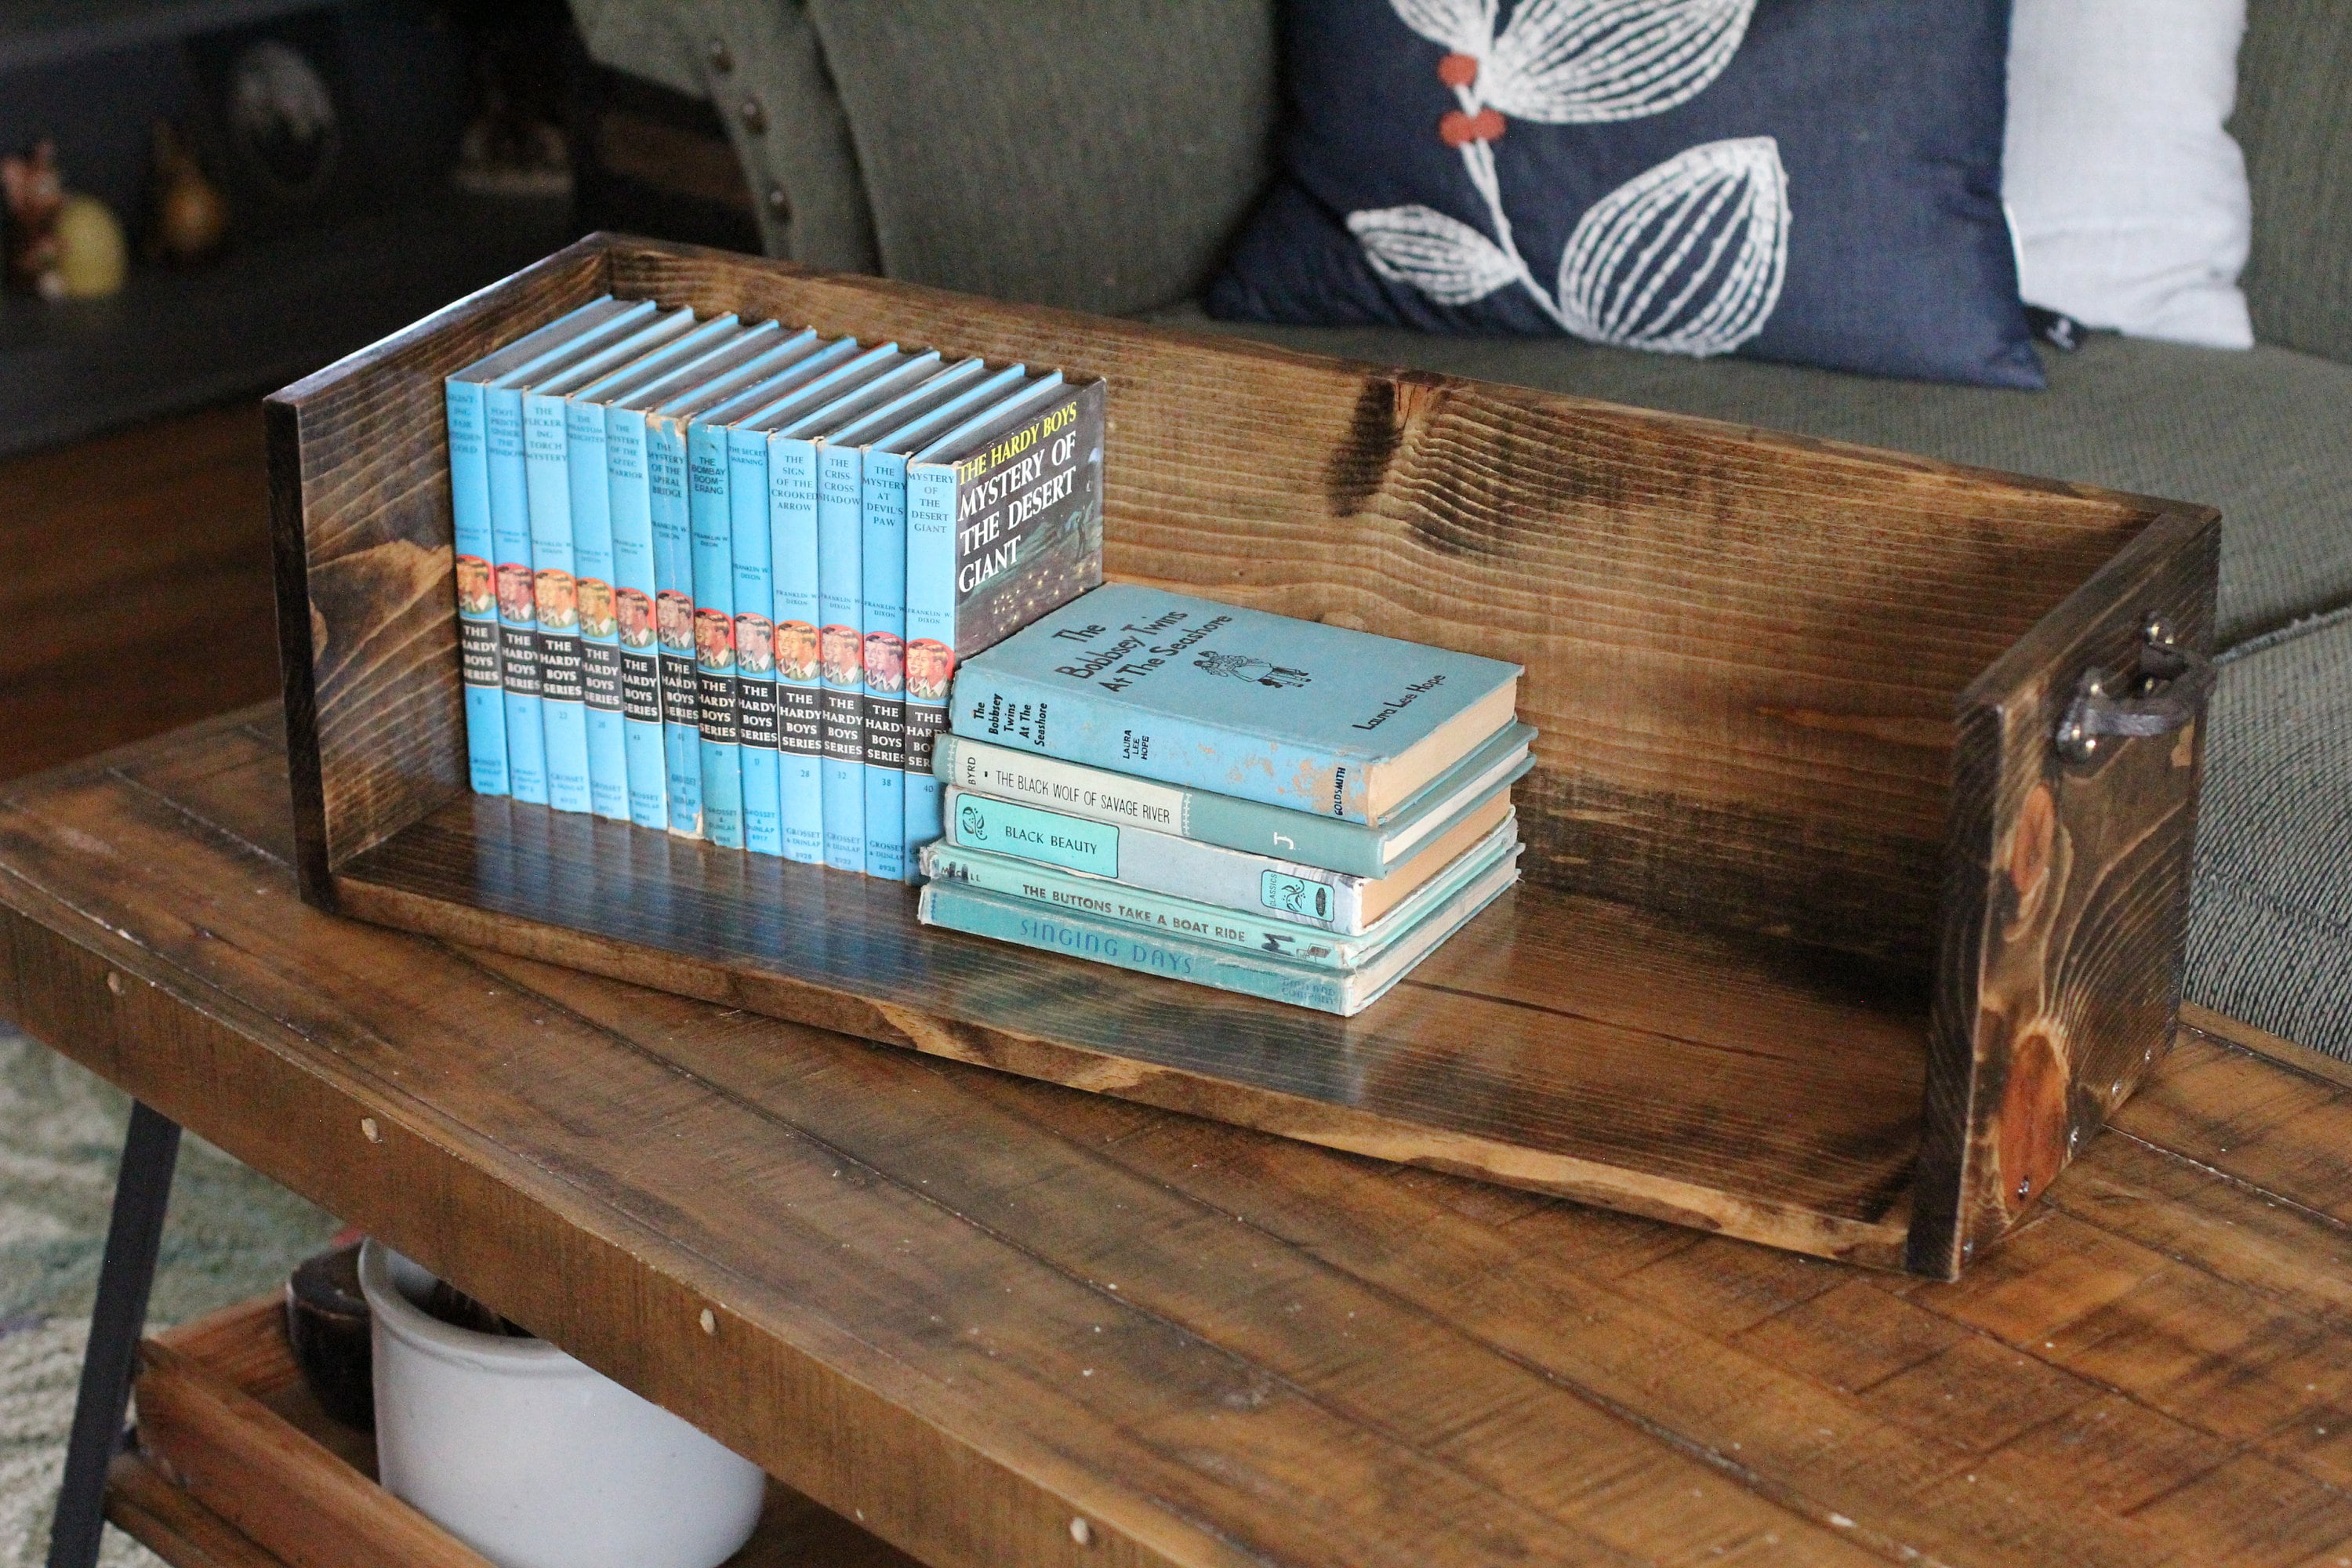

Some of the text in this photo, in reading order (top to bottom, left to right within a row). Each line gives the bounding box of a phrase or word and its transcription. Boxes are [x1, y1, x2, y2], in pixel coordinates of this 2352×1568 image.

[535, 407, 553, 416] THE
[577, 415, 590, 423] THE
[529, 441, 562, 450] TORCH
[608, 434, 640, 446] MYSTERY
[957, 401, 1077, 485] THE HARDY BOYS
[623, 448, 637, 456] THE
[656, 442, 671, 452] THE
[742, 448, 767, 457] SECRET
[526, 452, 567, 462] MYSTERY
[612, 458, 637, 467] AZTEC
[647, 451, 684, 464] MYSTERY
[699, 456, 715, 466] THE
[731, 456, 763, 466] WARNING
[784, 455, 804, 464] THE
[829, 458, 849, 468] THE
[609, 467, 643, 479] WARRIOR
[651, 463, 681, 475] OF THE
[691, 464, 725, 476] BOMBAY
[782, 467, 804, 476] SIGN
[873, 466, 895, 477] THE
[957, 430, 1076, 521] MYSTERY OF
[653, 475, 680, 487] SPIRAL
[693, 474, 724, 485] BOOM-
[776, 477, 813, 488] OF THE
[862, 477, 906, 491] MYSTERY
[908, 472, 955, 484] MYSTERY
[652, 485, 681, 499] BRIDGE
[695, 485, 724, 495] ERANG
[824, 481, 855, 492] CROSS
[924, 486, 938, 495] OF
[771, 488, 818, 501] CROOKED
[818, 494, 861, 506] SHADOW
[877, 492, 891, 501] AT
[777, 502, 812, 511] ARROW
[866, 502, 903, 516] DEVIL'S
[919, 498, 940, 508] THE
[911, 510, 949, 521] DESERT
[960, 466, 1076, 557] THE DESERT
[873, 516, 896, 527] PAW
[913, 523, 948, 534] GIANT
[958, 534, 1022, 593] GIANT
[776, 590, 808, 598] FRANKLIN
[822, 593, 851, 603] FRANKLIN
[864, 601, 896, 611] FRANKLIN
[907, 608, 941, 617] FRANKLIN
[873, 610, 896, 619] DIXON
[463, 625, 488, 637] THE
[1051, 624, 1106, 643] The
[506, 633, 531, 646] THE
[545, 639, 572, 652] THE
[1054, 612, 1189, 679] Bobbsey Twins
[463, 654, 494, 666] BOYS
[539, 653, 581, 666] HARDY
[585, 648, 610, 661] THE
[1098, 615, 1232, 692] At The Seashore
[506, 662, 536, 675] BOYS
[582, 662, 619, 676] HARDY
[623, 658, 648, 672] THE
[666, 661, 690, 674] THE
[546, 669, 577, 681] BOYS
[622, 673, 657, 688] HARDY
[504, 676, 540, 690] SERIES
[586, 677, 615, 691] BOYS
[662, 674, 698, 690] HARDY
[701, 679, 727, 692] THE
[543, 683, 583, 696] SERIES
[624, 688, 653, 702] BOYS
[742, 684, 768, 698] THE
[584, 691, 619, 706] SERIES
[666, 691, 695, 705] BOYS
[698, 693, 736, 708] HARDY
[786, 692, 813, 705] THE
[829, 696, 855, 710] THE
[1352, 675, 1446, 731] Laura Lee Hope
[739, 699, 777, 713] HARDY
[872, 704, 898, 717] THE
[973, 701, 985, 720] The
[702, 708, 731, 722] BOYS
[779, 706, 822, 720] HARDY
[822, 710, 863, 725] HARDY
[914, 711, 942, 724] THE
[989, 693, 1003, 735] Bobbsey
[1004, 702, 1016, 733] Twins
[742, 714, 773, 728] BOYS
[1019, 703, 1032, 739] At The
[1034, 702, 1048, 747] Seashore
[699, 724, 736, 738] SERIES
[740, 728, 778, 742] SERIES
[786, 722, 817, 735] BOYS
[828, 727, 858, 740] BOYS
[782, 736, 822, 750] SERIES
[871, 734, 902, 748] BOYS
[1123, 729, 1132, 760] LAURA
[1132, 738, 1141, 755] LEE
[1141, 735, 1149, 760] HOPE
[824, 741, 862, 755] SERIES
[867, 749, 906, 763] SERIES
[800, 769, 810, 778] 28
[837, 771, 847, 780] 32
[967, 756, 977, 785] BYRD
[882, 778, 891, 786] 38
[924, 785, 934, 793] 40
[1334, 767, 1346, 816] GOLDSMITH
[996, 770, 1171, 824] THE BLACK WOLF OF SAVAGE RIVER
[786, 826, 821, 839] GROSSET
[826, 833, 861, 844] GROSSET
[793, 838, 821, 848] DUNLAP
[869, 840, 904, 851] GROSSET
[1005, 826, 1098, 855] BLACK BEAUTY
[1022, 884, 1246, 942] THE BUTTONS TAKE A BOAT RIDE
[1133, 945, 1192, 974] DAYS
